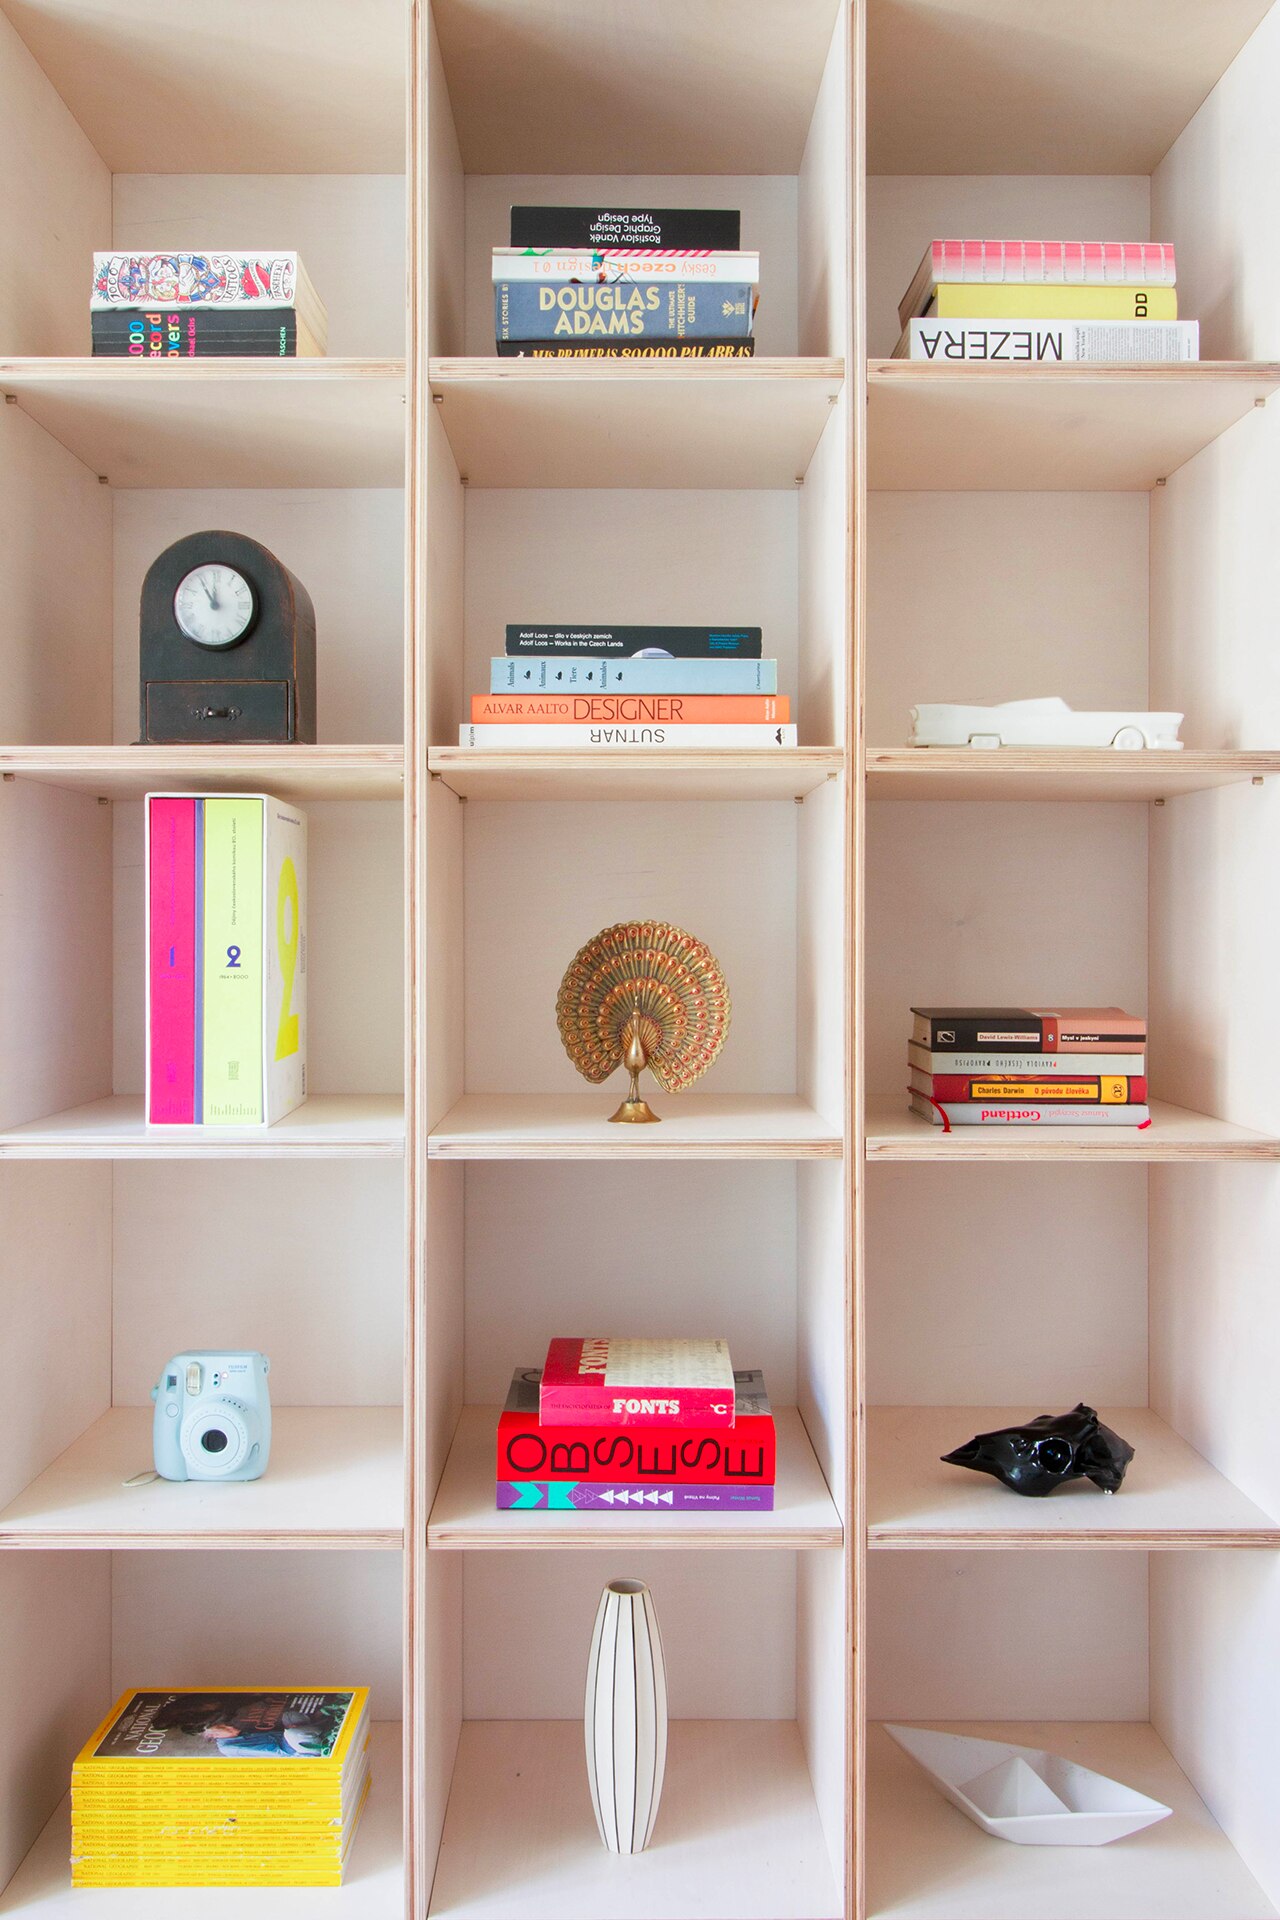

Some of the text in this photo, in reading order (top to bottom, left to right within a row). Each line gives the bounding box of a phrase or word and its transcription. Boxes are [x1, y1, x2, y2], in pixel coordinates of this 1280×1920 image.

[589, 222, 661, 235] Graphic Design
[597, 212, 654, 225] Type Design
[589, 233, 661, 244] Rostislav Vaněk
[222, 259, 238, 300] TATTOOS
[617, 262, 677, 274] czech
[681, 260, 717, 277] český
[108, 267, 120, 300] 1000
[539, 286, 660, 312] DOUGLAS
[687, 296, 696, 324] GUIDE
[554, 310, 645, 335] ADAMS
[128, 320, 145, 358] 000
[145, 313, 163, 358] ecord
[167, 313, 181, 358] overs
[279, 326, 287, 356] TASCHEN
[919, 330, 1063, 360] MEZERA
[589, 640, 606, 648] Czech
[507, 661, 515, 688] Animals
[483, 698, 684, 721] ALVAR AALTO DESIGNER
[590, 728, 665, 743] SUTNAR
[226, 945, 241, 968] 2
[977, 1086, 1025, 1094] Charles Darwin
[981, 1109, 1041, 1122] Gottland
[578, 1337, 609, 1375] FONTS
[612, 1399, 680, 1415] FONTS
[506, 1433, 764, 1477] OBSESE
[123, 1703, 161, 1741] NATIONAL
